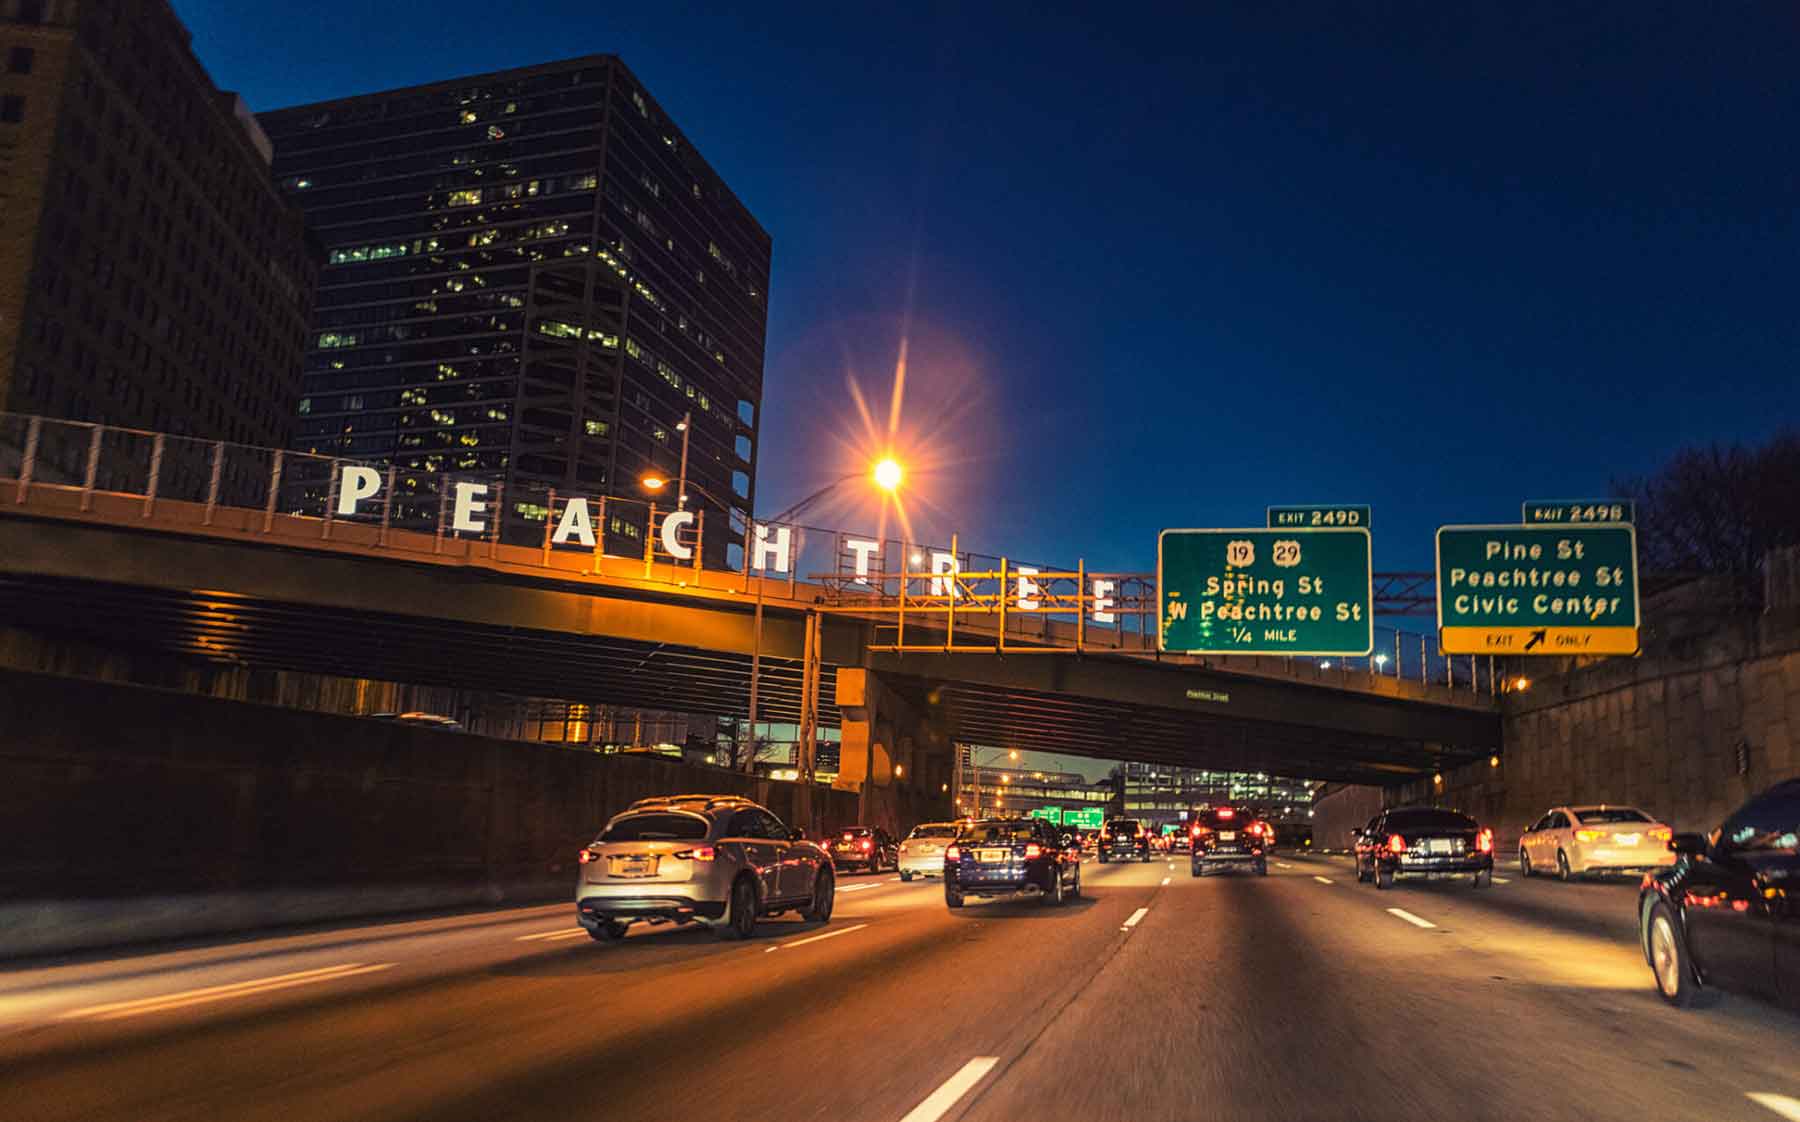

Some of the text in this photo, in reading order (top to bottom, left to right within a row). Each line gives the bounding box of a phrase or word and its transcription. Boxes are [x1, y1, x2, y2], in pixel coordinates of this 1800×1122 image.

[1278, 511, 1359, 524] EXIT 249D
[338, 466, 1114, 623] PEACHTREE
[1232, 546, 1298, 561] 19 29
[1486, 539, 1585, 560] Pine St
[1451, 566, 1624, 587] Peachtree St
[1207, 576, 1323, 598] Spring St
[1170, 602, 1361, 621] W Peachtree St
[1455, 594, 1621, 615] Civic Center
[1264, 629, 1297, 642] MILE
[1486, 633, 1592, 646] EXIT ONLY
